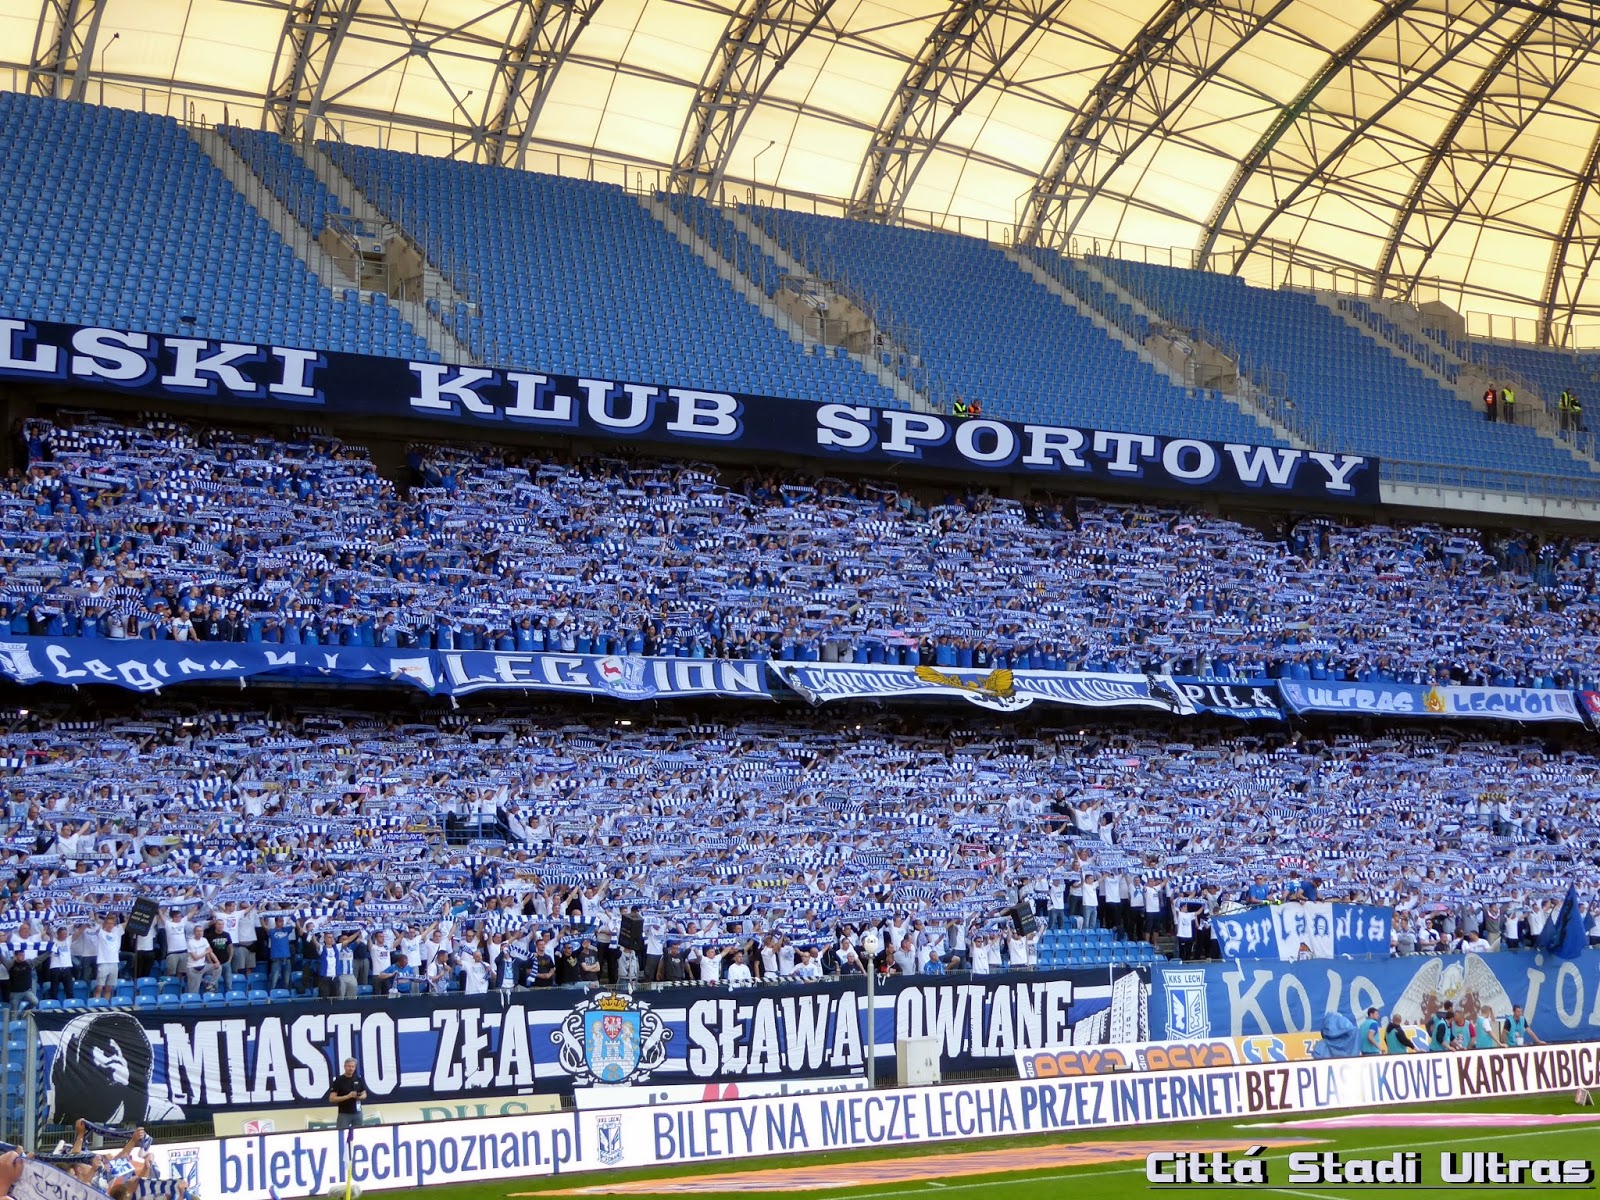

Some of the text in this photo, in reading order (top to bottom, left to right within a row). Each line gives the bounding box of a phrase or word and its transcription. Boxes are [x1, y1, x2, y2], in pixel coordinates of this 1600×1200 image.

[408, 361, 740, 436] KLUB
[815, 403, 1364, 492] SPORTOWY
[1181, 684, 1278, 708] PIŁA
[1306, 687, 1414, 712] ULTRAS
[1216, 907, 1386, 958] Pyrlandia
[1168, 974, 1201, 983] KKS LECH
[163, 1011, 398, 1105] MIASTO
[896, 978, 1072, 1058] OWIANE
[653, 1105, 758, 1161] BILETY
[766, 1102, 809, 1152] NA
[820, 1093, 920, 1147] MECZE
[924, 1086, 1017, 1138] LECHA
[1021, 1080, 1107, 1130] PRZEZ
[1110, 1071, 1243, 1123] INTERNET!
[1247, 1068, 1291, 1113] BEZ
[1457, 1051, 1529, 1096] KARTY
[1533, 1047, 1600, 1090] KIBIC
